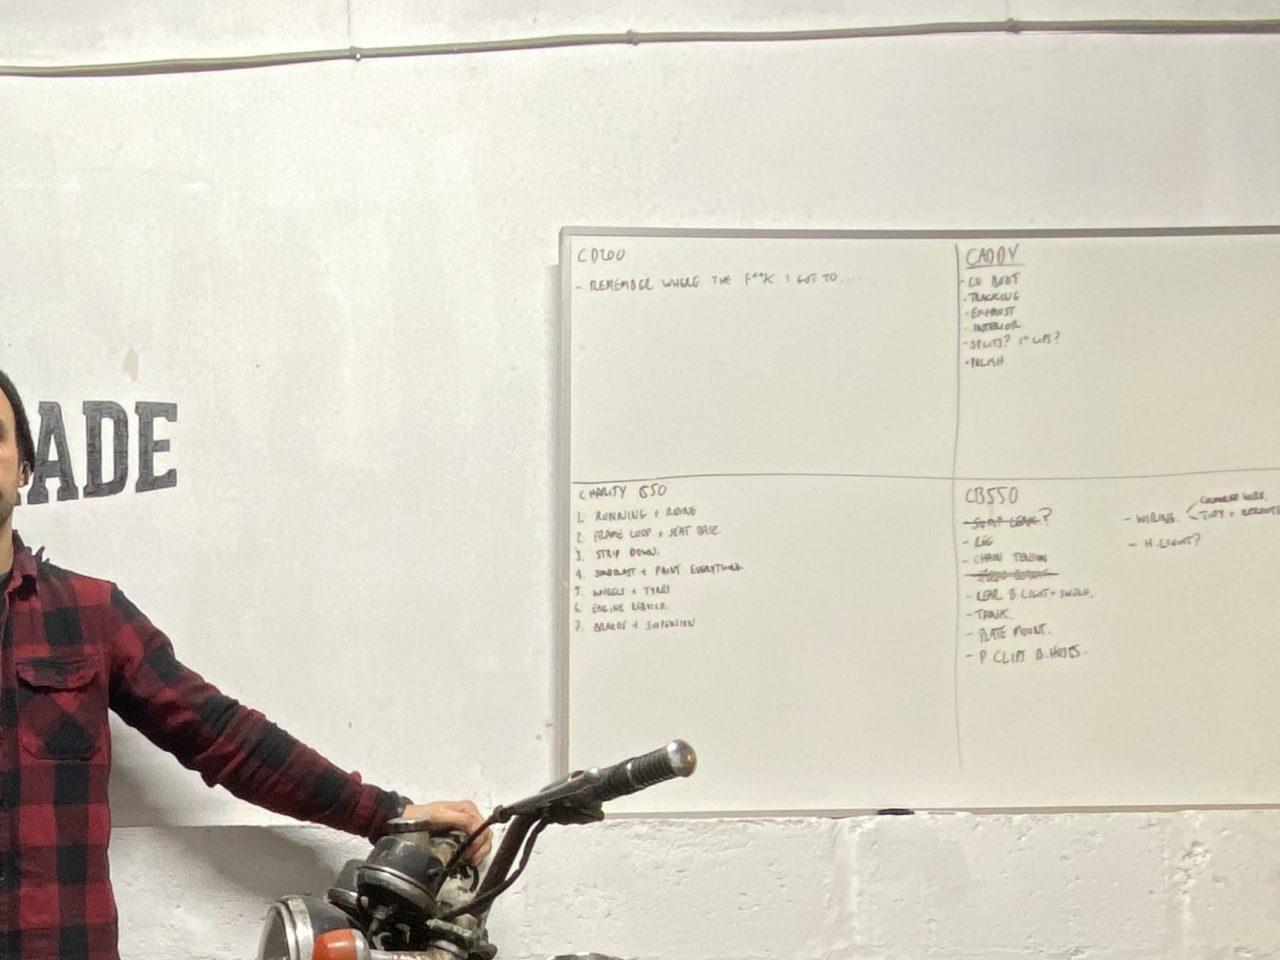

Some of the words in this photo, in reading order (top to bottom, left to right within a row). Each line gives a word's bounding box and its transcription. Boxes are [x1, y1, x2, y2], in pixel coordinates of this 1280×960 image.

[965, 243, 1020, 266] CADDY
[12, 400, 178, 506] ADE
[579, 485, 627, 500] CHARITY
[965, 486, 1019, 505] CB550
